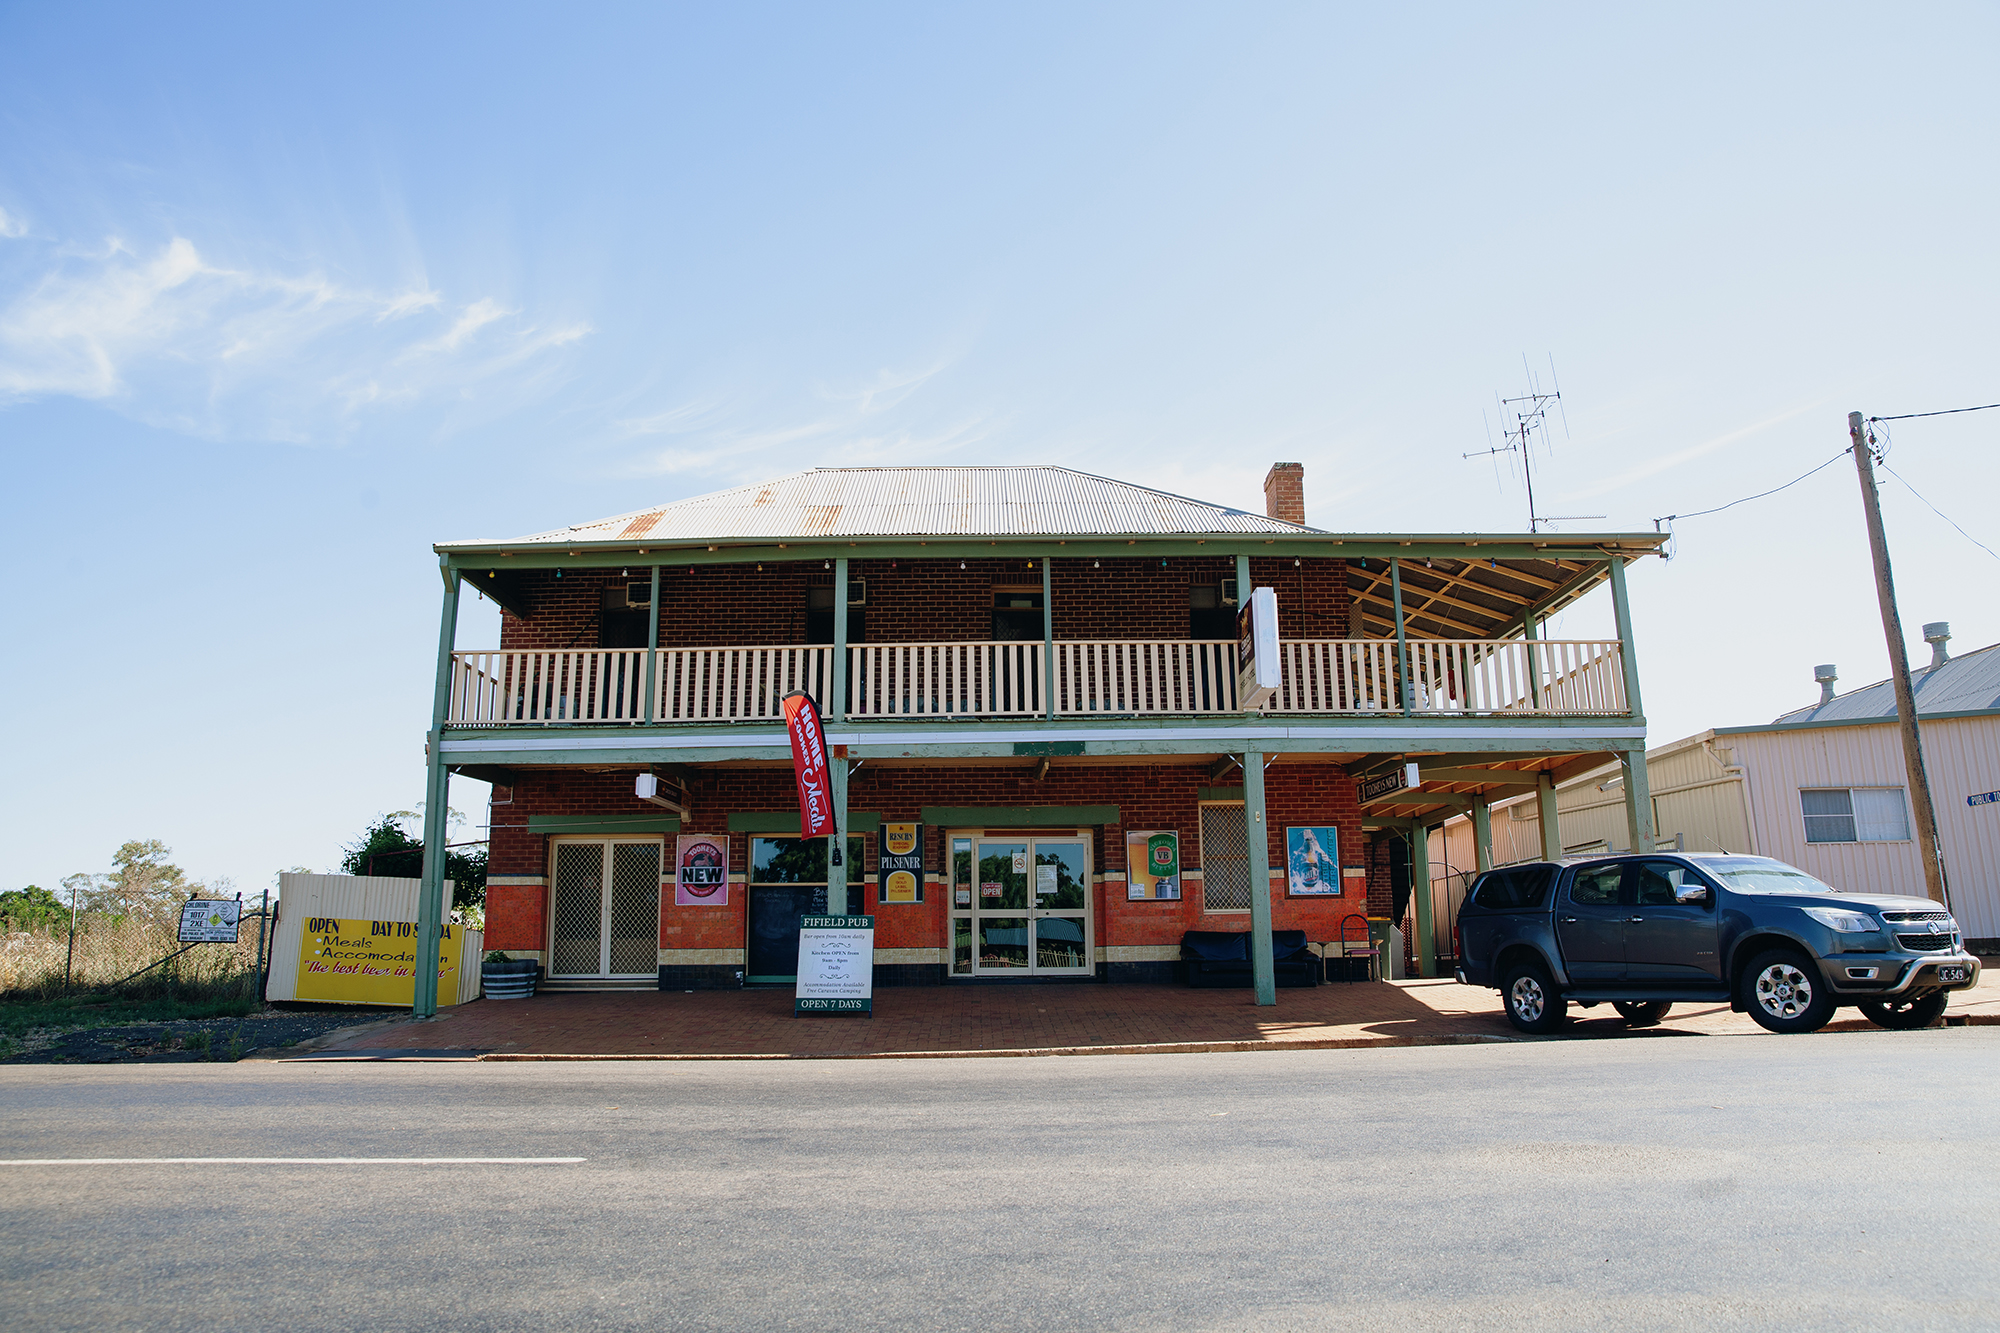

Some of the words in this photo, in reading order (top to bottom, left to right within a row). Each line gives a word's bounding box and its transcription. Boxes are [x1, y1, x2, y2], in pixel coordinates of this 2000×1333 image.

[793, 716, 811, 766] COOKED
[800, 704, 824, 772] HOME
[1971, 793, 1992, 805] PUBLIC
[689, 845, 717, 856] TOOHEYS
[1157, 851, 1169, 860] VB
[881, 856, 921, 869] PILSENER
[682, 868, 723, 883] NEW
[983, 887, 1001, 896] OPEN
[309, 917, 340, 934] OPEN
[371, 920, 394, 937] DAY
[397, 921, 411, 938] TO
[804, 918, 845, 926] FIFIELD
[848, 918, 868, 926] PUB
[322, 935, 372, 949] Meals
[321, 947, 448, 963] Accomodan
[332, 960, 361, 975] best
[362, 963, 392, 977] beer
[394, 965, 410, 978] in
[801, 1000, 827, 1009] OPEN
[830, 1000, 837, 1008] 7
[838, 1000, 862, 1009] DAYS
